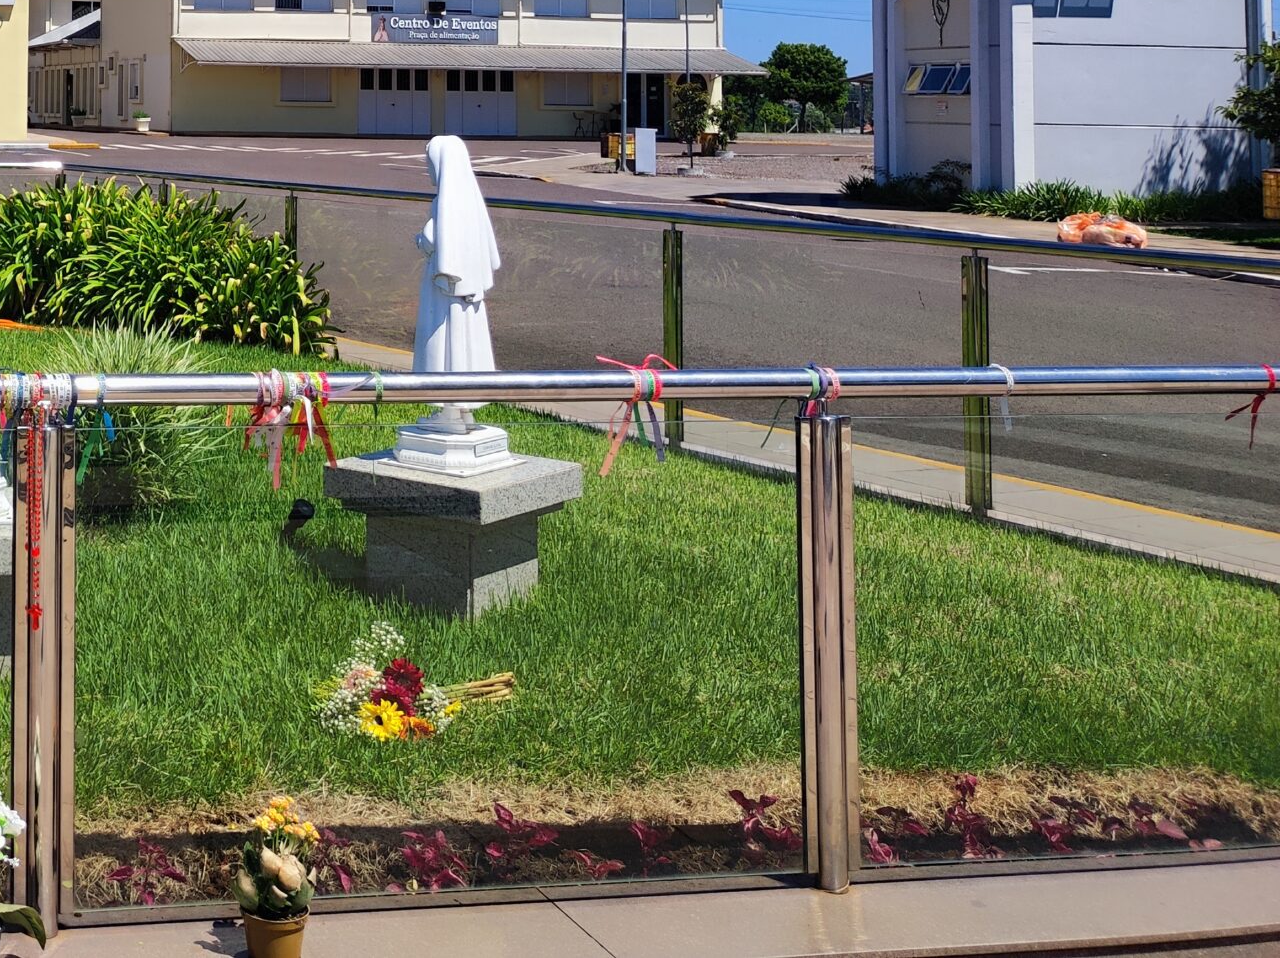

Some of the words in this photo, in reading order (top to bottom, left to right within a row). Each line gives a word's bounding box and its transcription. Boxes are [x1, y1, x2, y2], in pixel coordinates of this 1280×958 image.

[390, 17, 430, 29] Centro
[433, 18, 449, 29] De
[452, 18, 497, 30] Eventos
[409, 31, 428, 40] Praça
[440, 32, 480, 41] alimentação
